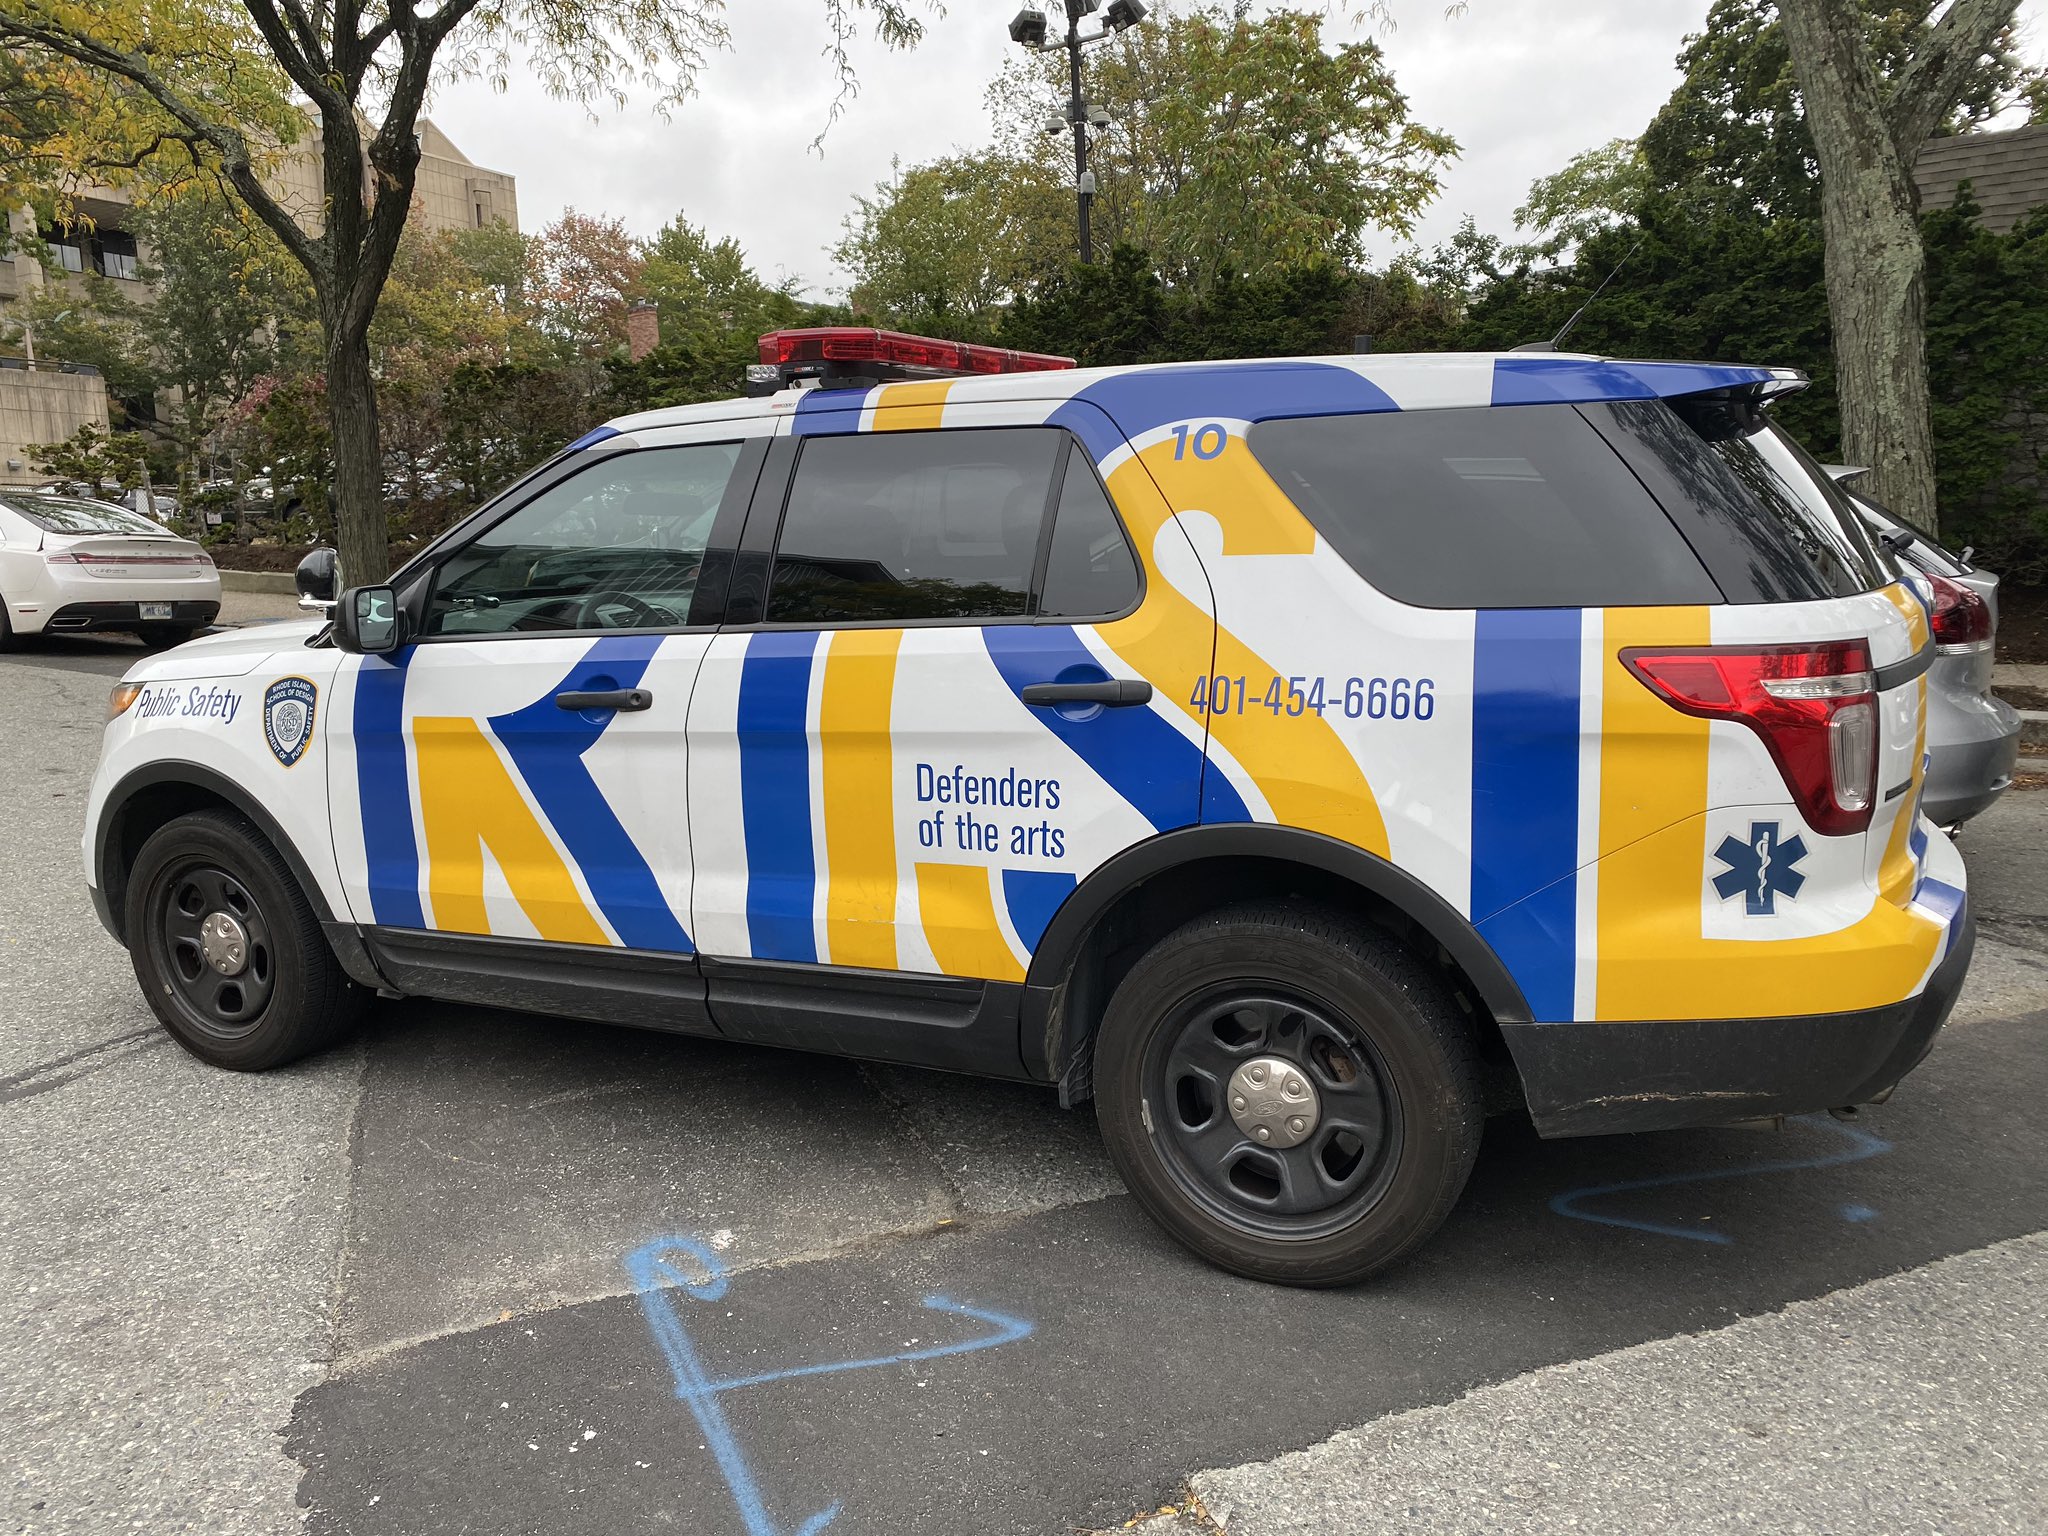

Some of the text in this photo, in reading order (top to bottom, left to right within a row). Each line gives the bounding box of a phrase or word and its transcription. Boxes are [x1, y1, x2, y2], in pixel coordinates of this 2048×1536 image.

[1171, 423, 1228, 461] 10
[134, 686, 242, 725] Public Safety
[266, 689, 314, 705] SCHOOL OF DESIGN
[273, 680, 311, 693] RHODE ISLAND
[1190, 675, 1435, 721] 401-454-6666
[265, 708, 281, 753] DEPARTMENT
[279, 750, 288, 761] OF
[290, 736, 308, 760] PUBLIC
[304, 705, 314, 735] SAFETY
[916, 763, 1061, 810] Defenders
[918, 810, 1066, 859] of the arts
